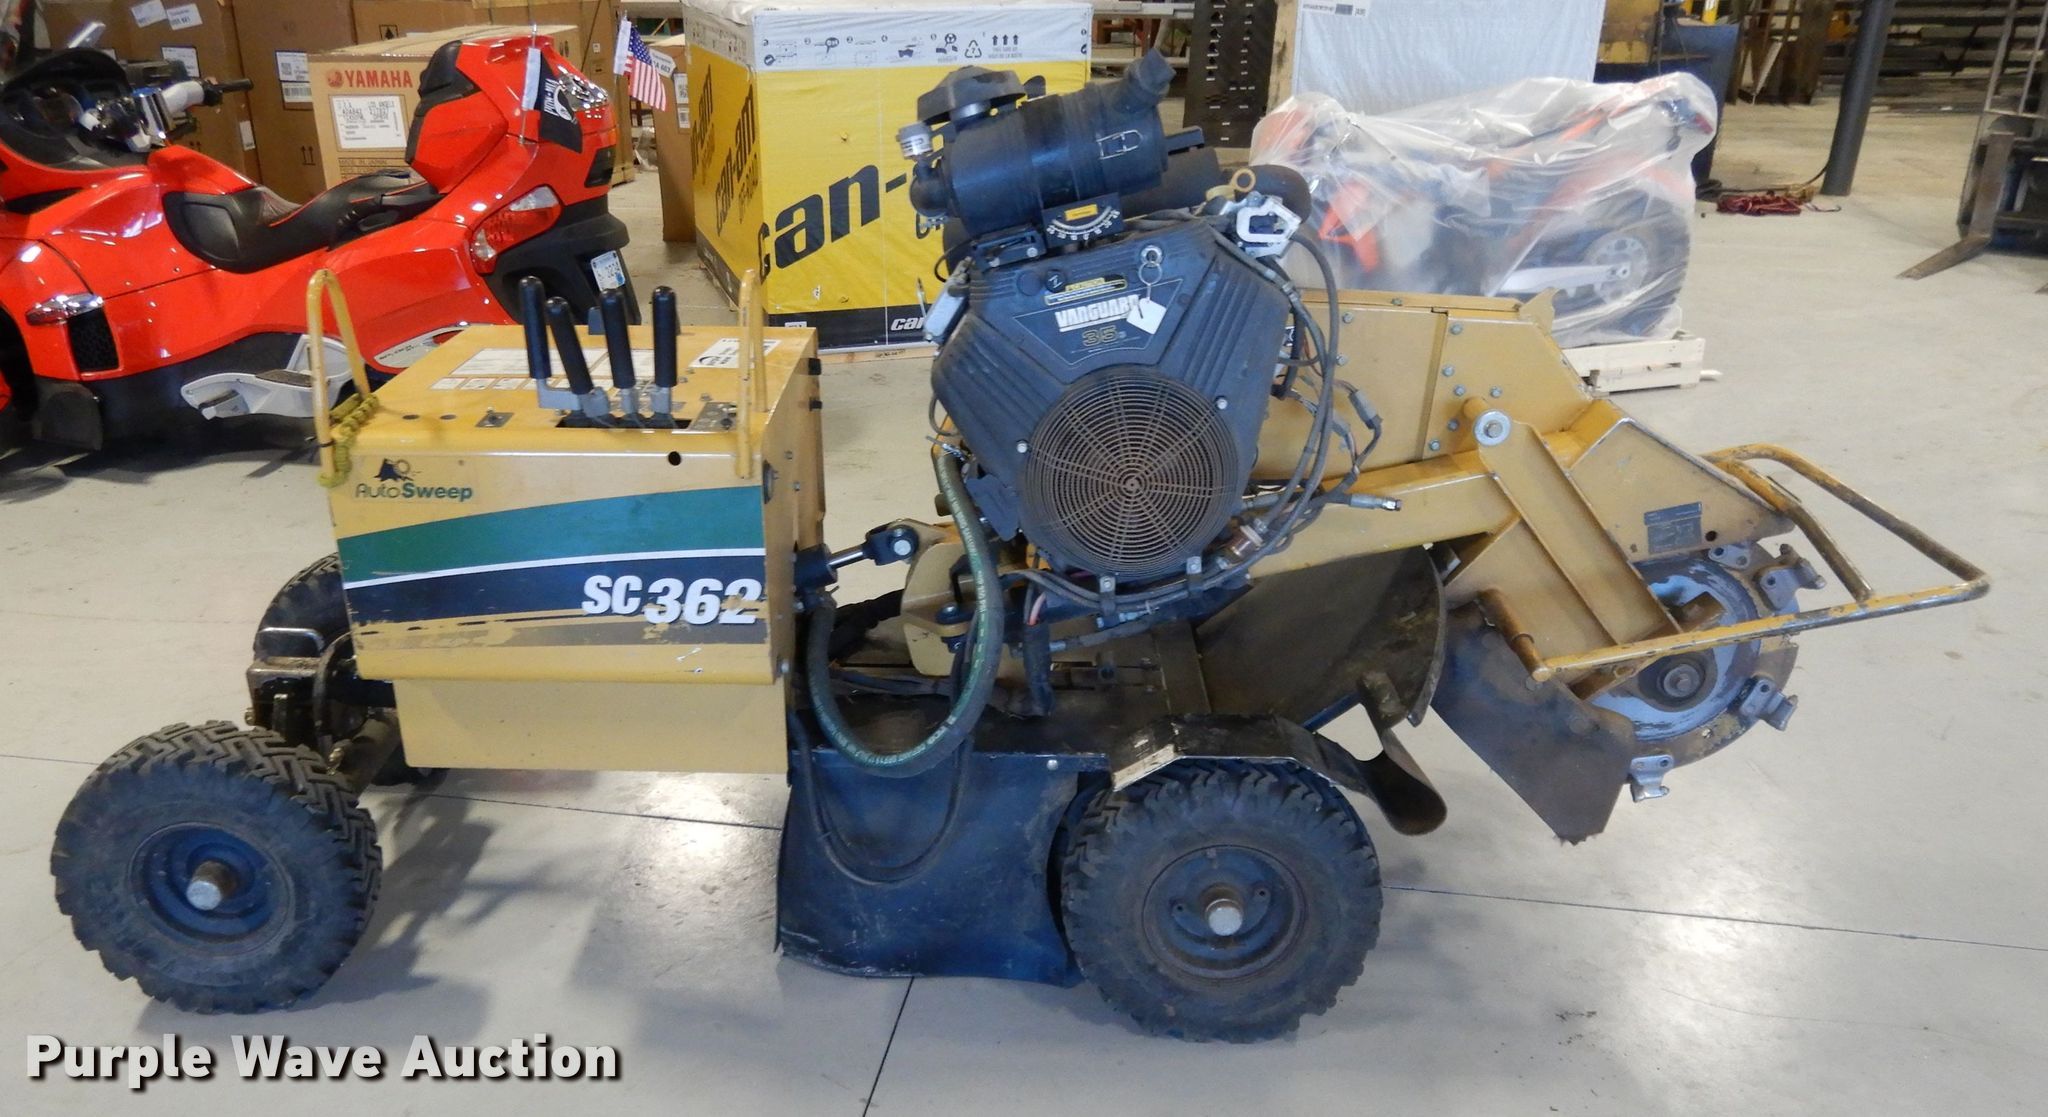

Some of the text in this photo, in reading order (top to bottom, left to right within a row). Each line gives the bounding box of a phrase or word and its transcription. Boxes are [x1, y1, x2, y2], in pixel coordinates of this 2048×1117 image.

[344, 70, 413, 88] YAMAHA
[1082, 325, 1118, 347] 35
[355, 482, 473, 502] AutoSweep
